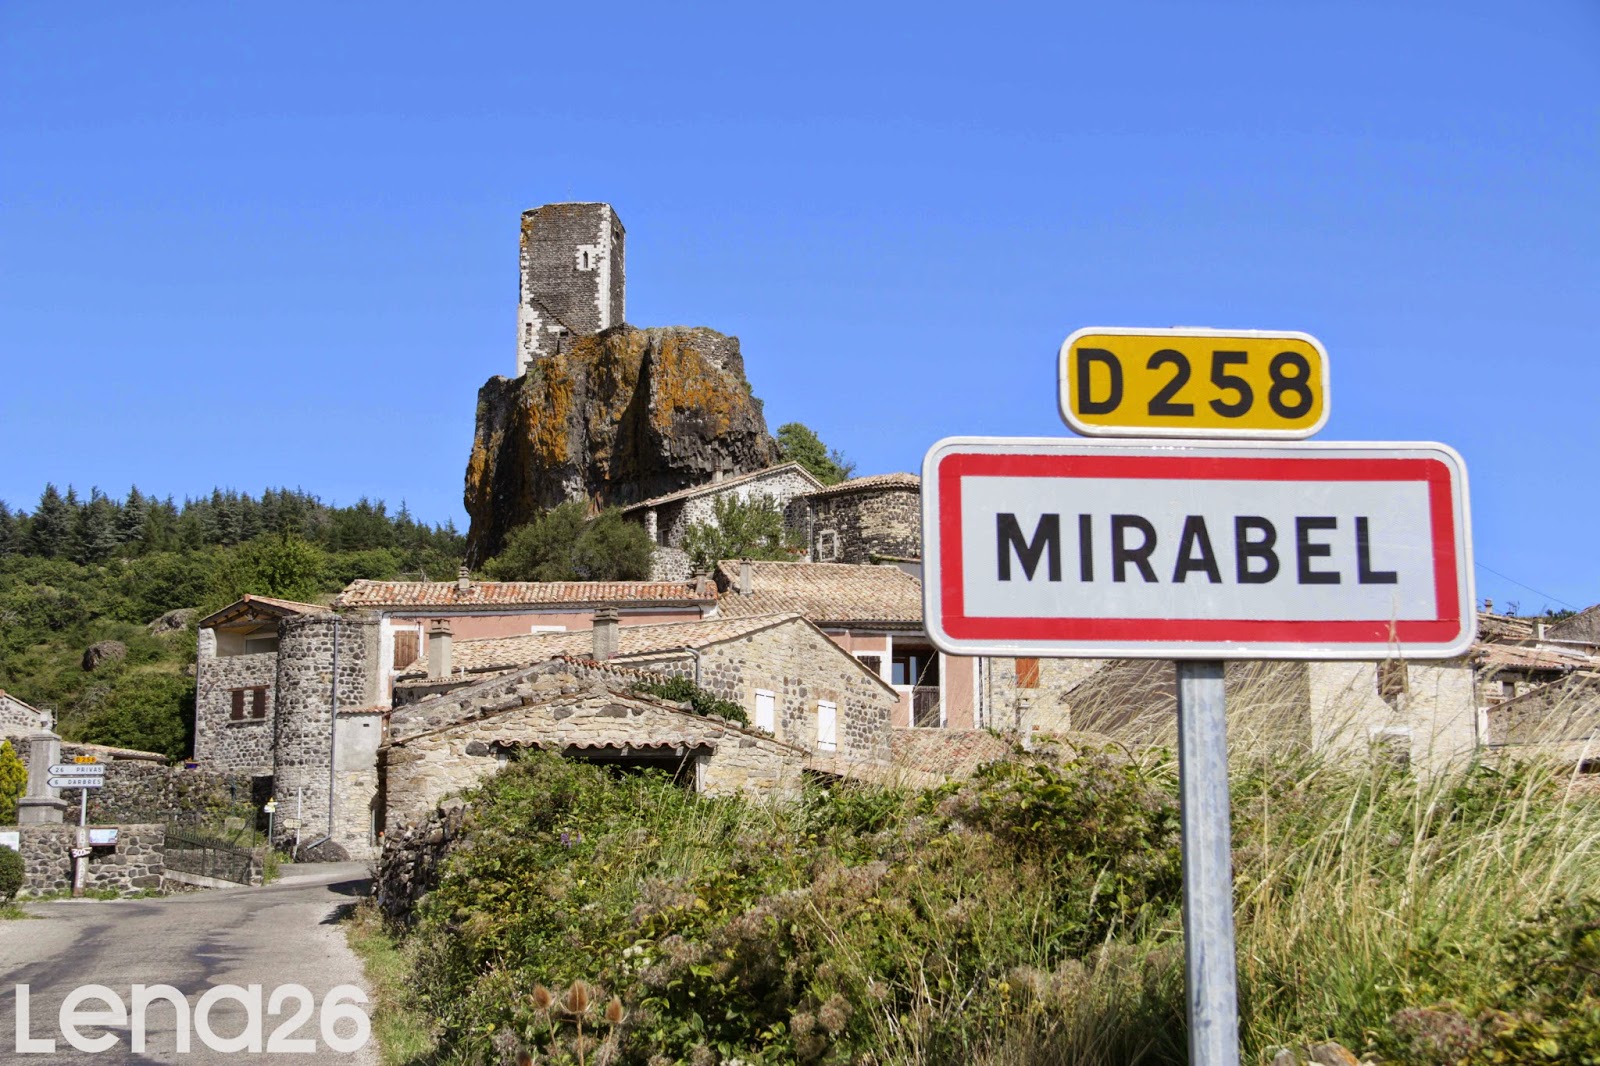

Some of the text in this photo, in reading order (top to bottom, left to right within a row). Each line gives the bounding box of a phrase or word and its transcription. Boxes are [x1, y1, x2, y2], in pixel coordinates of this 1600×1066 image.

[1076, 347, 1315, 420] D 258
[995, 512, 1399, 585] MIRABEL
